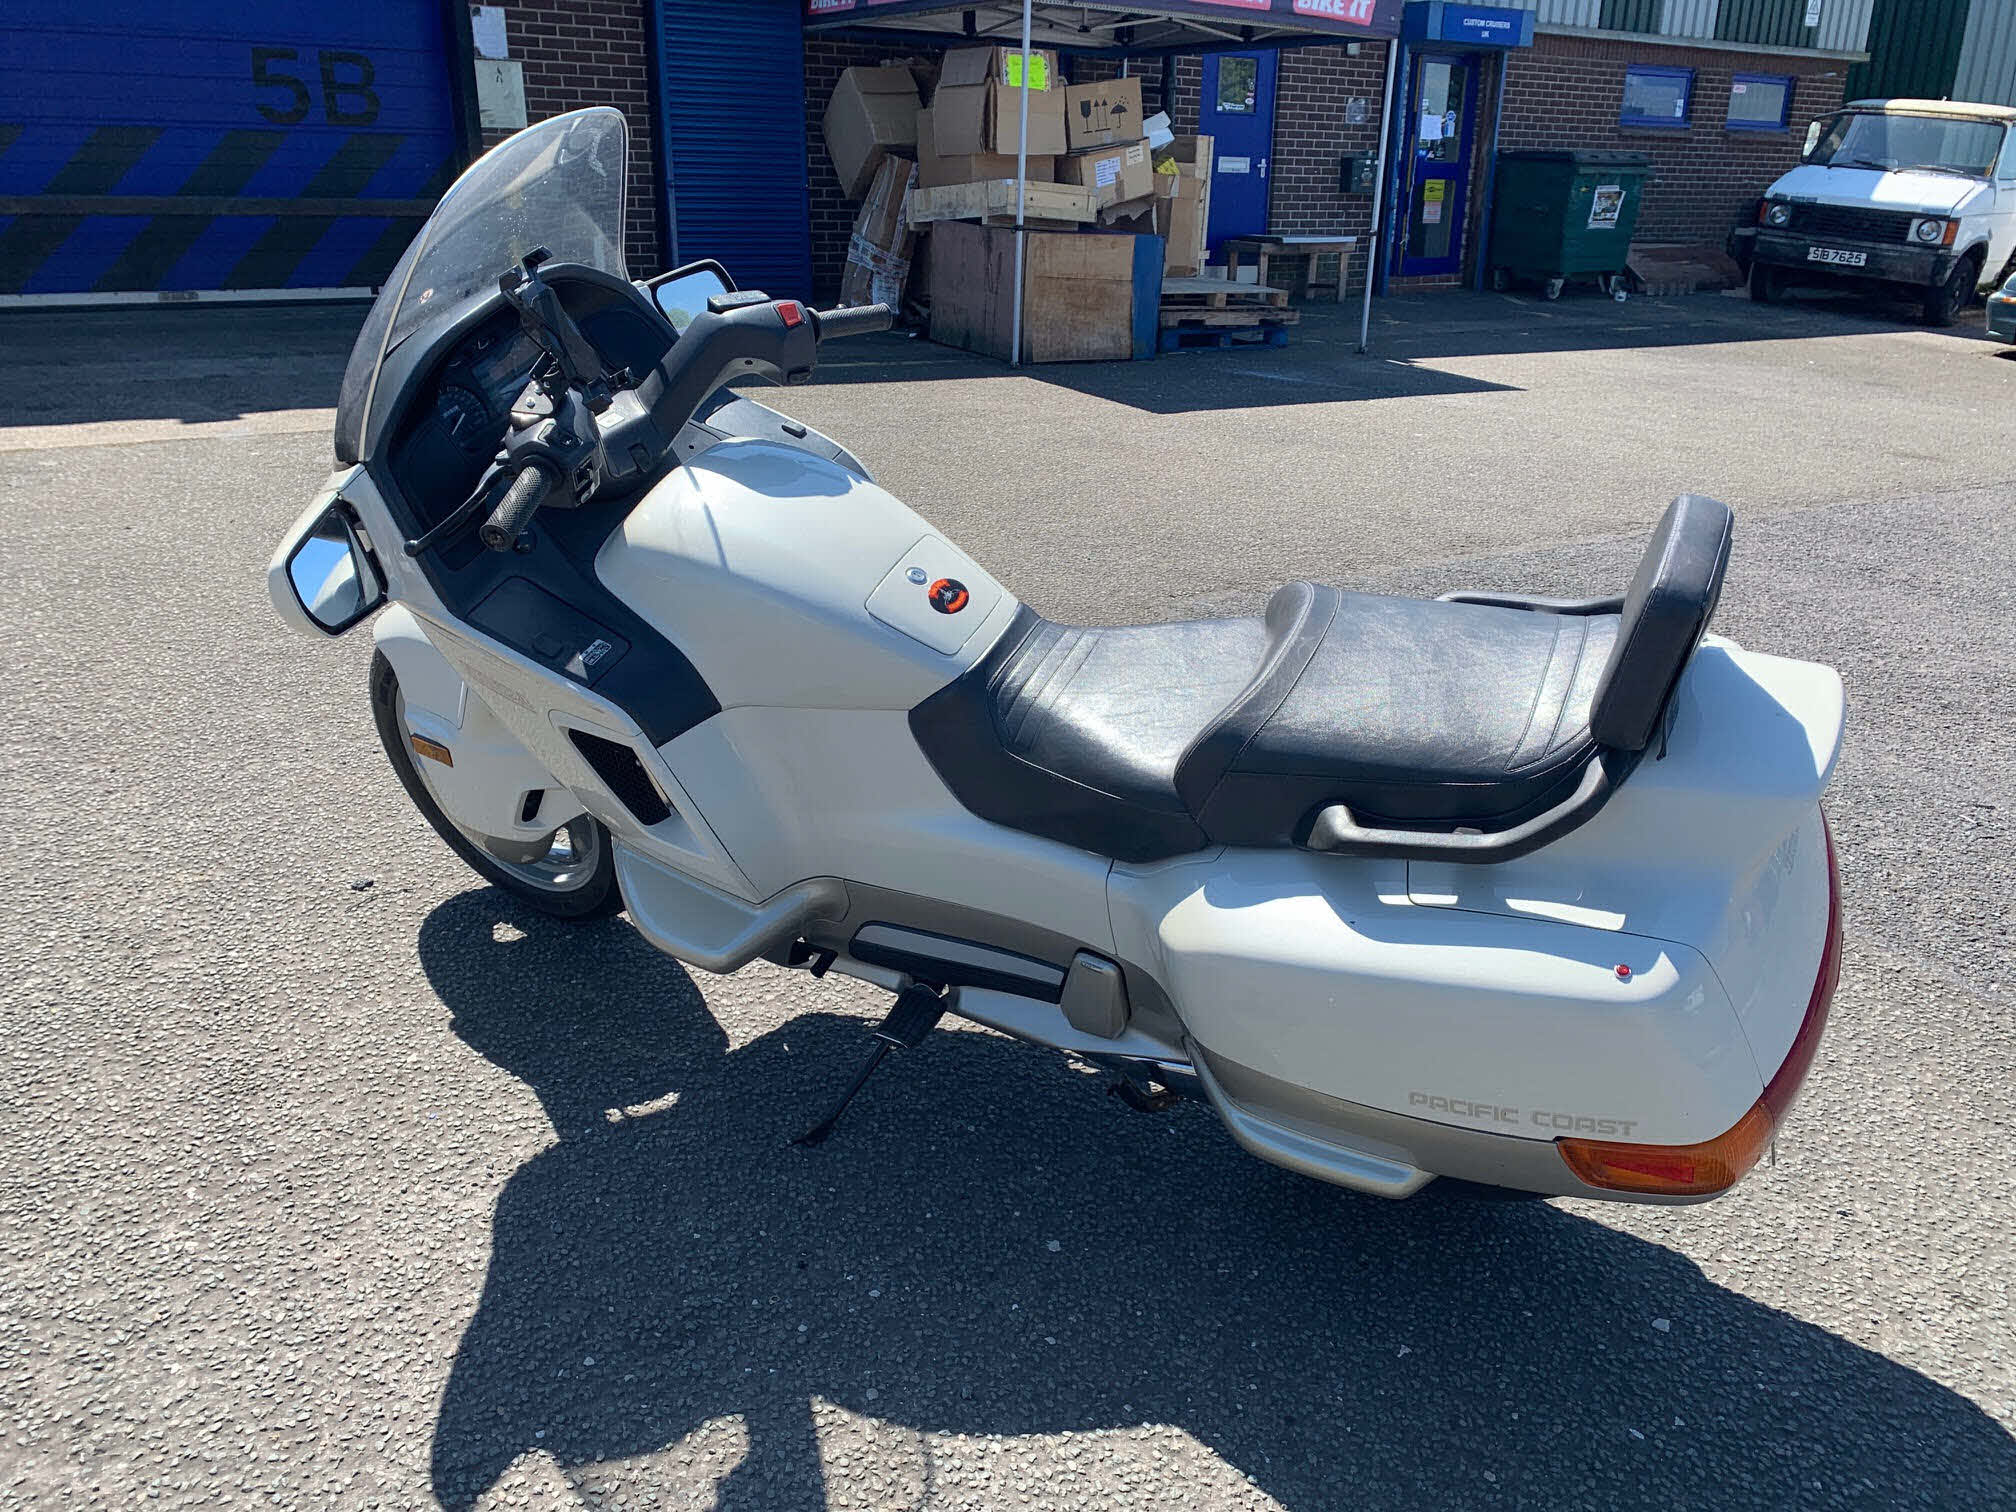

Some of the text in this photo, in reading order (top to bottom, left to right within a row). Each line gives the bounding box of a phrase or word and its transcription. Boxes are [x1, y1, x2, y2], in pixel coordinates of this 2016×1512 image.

[1350, 0, 1371, 18] IT
[251, 47, 381, 127] 5B
[1831, 251, 1862, 264] 7625
[1408, 1091, 1639, 1137] PACIFIC COAST
